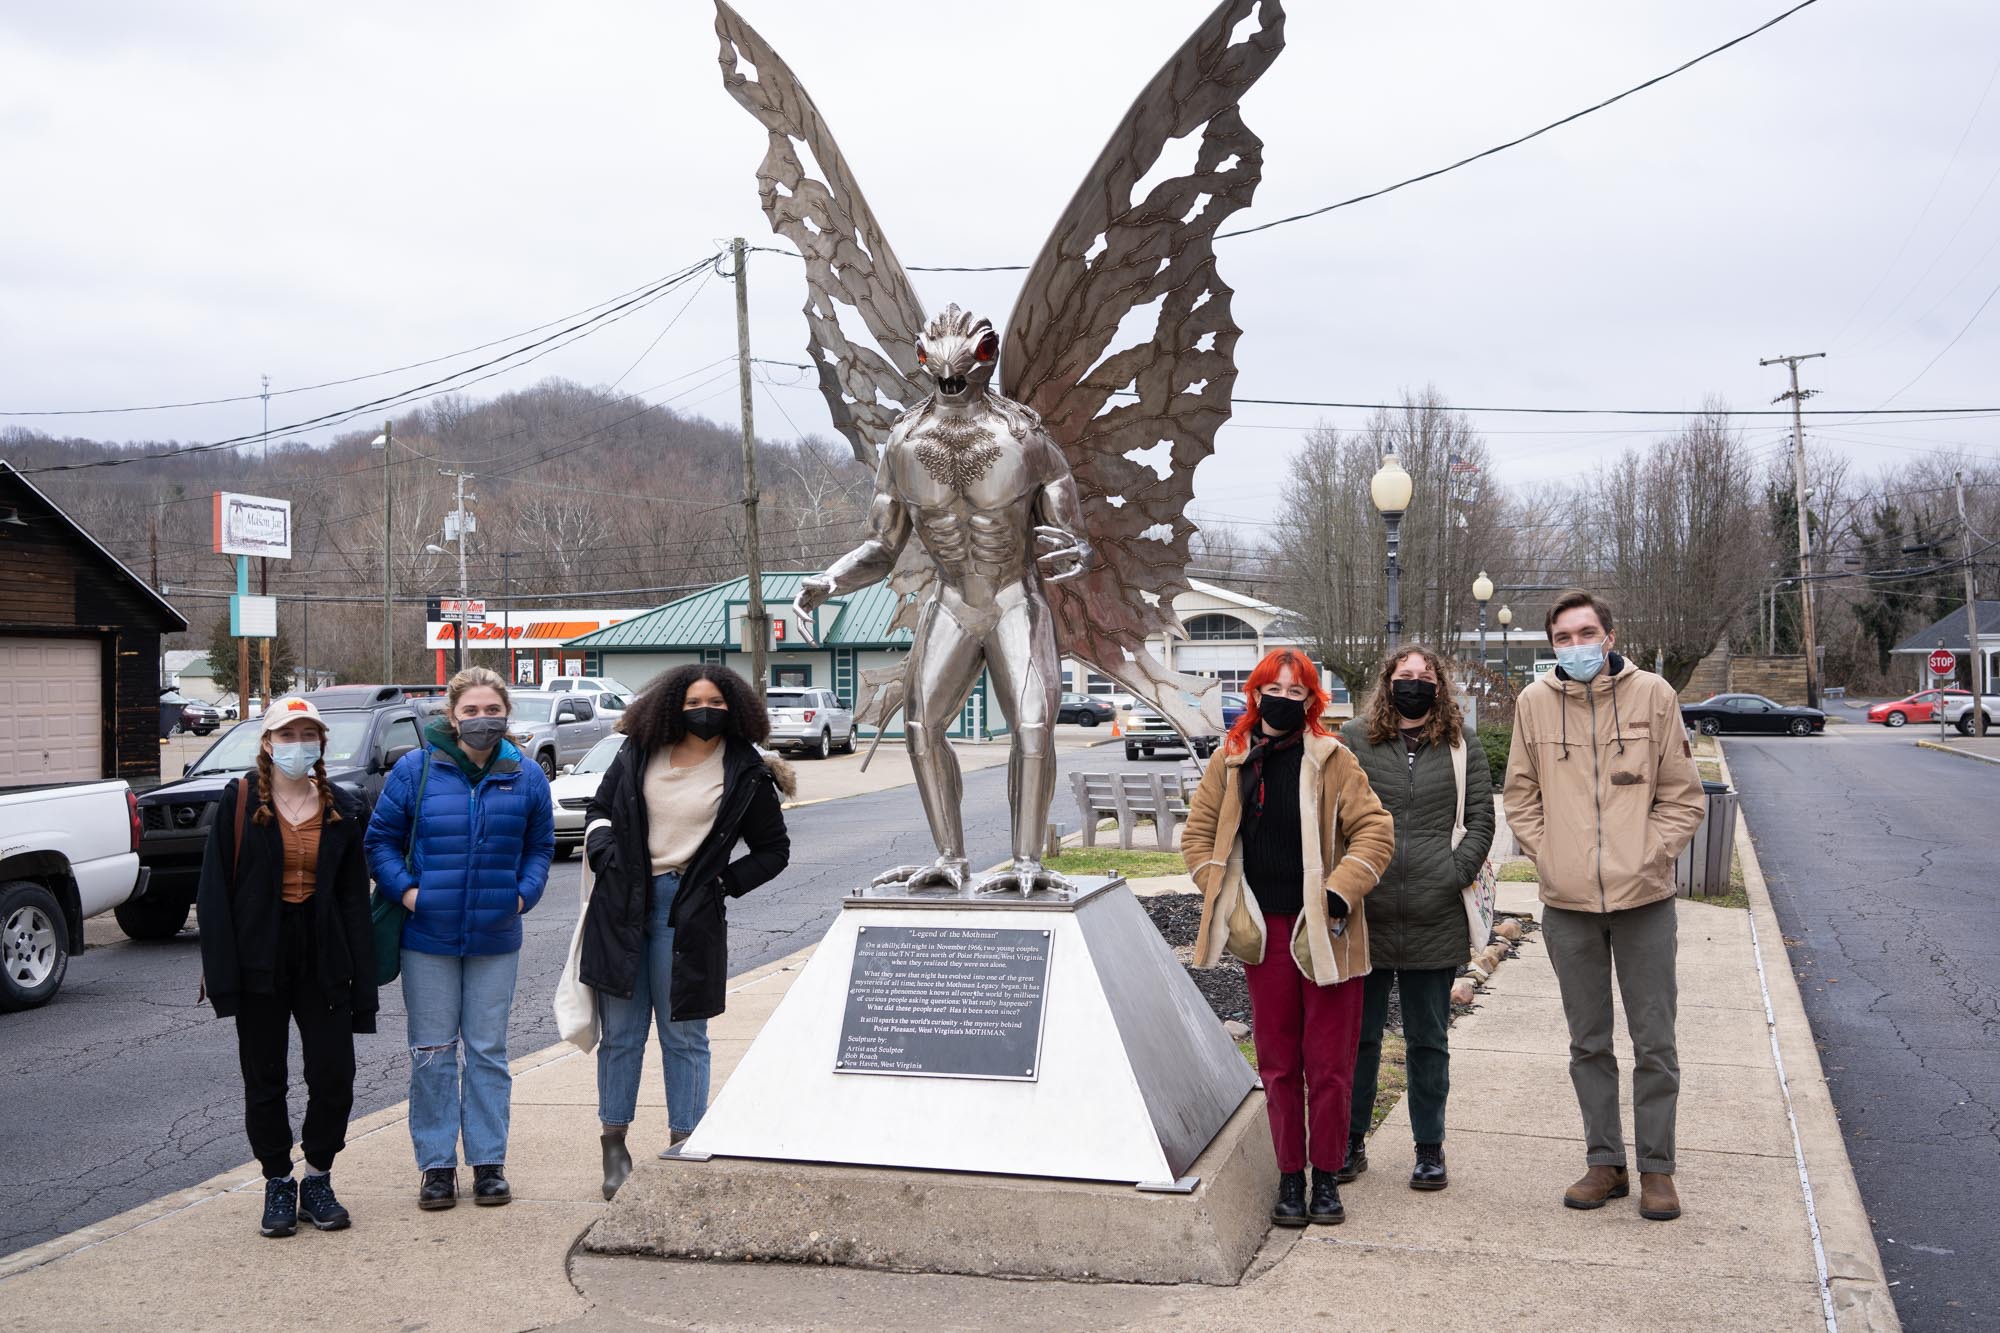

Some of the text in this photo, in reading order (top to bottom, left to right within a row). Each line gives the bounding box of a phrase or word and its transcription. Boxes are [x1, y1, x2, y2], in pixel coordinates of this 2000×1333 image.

[246, 513, 282, 529] Mason Jar
[453, 600, 484, 612] AuZone
[437, 623, 523, 640] AoZone
[1931, 657, 1953, 667] STOP
[921, 972, 936, 980] night
[931, 1019, 958, 1027] curiosity
